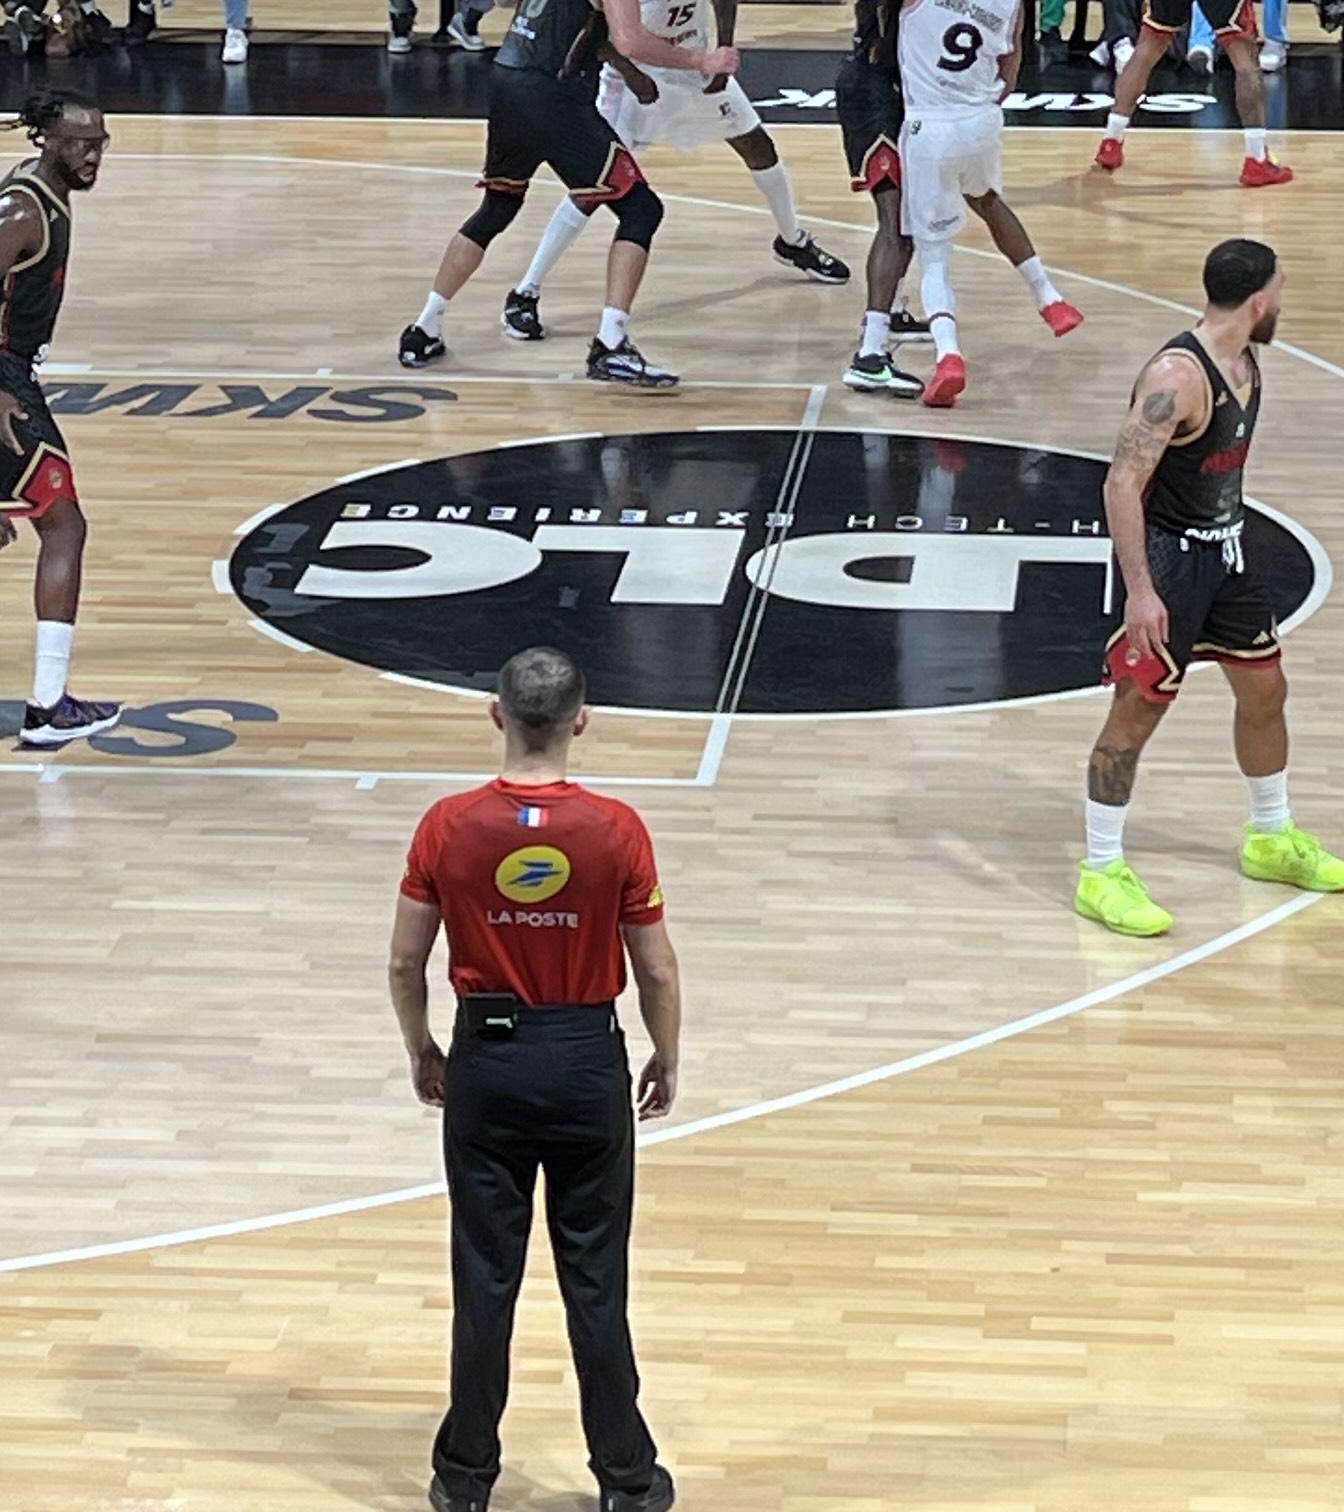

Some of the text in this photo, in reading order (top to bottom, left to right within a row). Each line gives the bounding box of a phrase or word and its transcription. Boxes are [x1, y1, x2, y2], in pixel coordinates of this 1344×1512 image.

[666, 3, 697, 27] 15
[937, 21, 984, 73] 9
[338, 500, 1101, 534] H-TECH EXPERIENCE
[487, 910, 579, 929] LA POSTE
